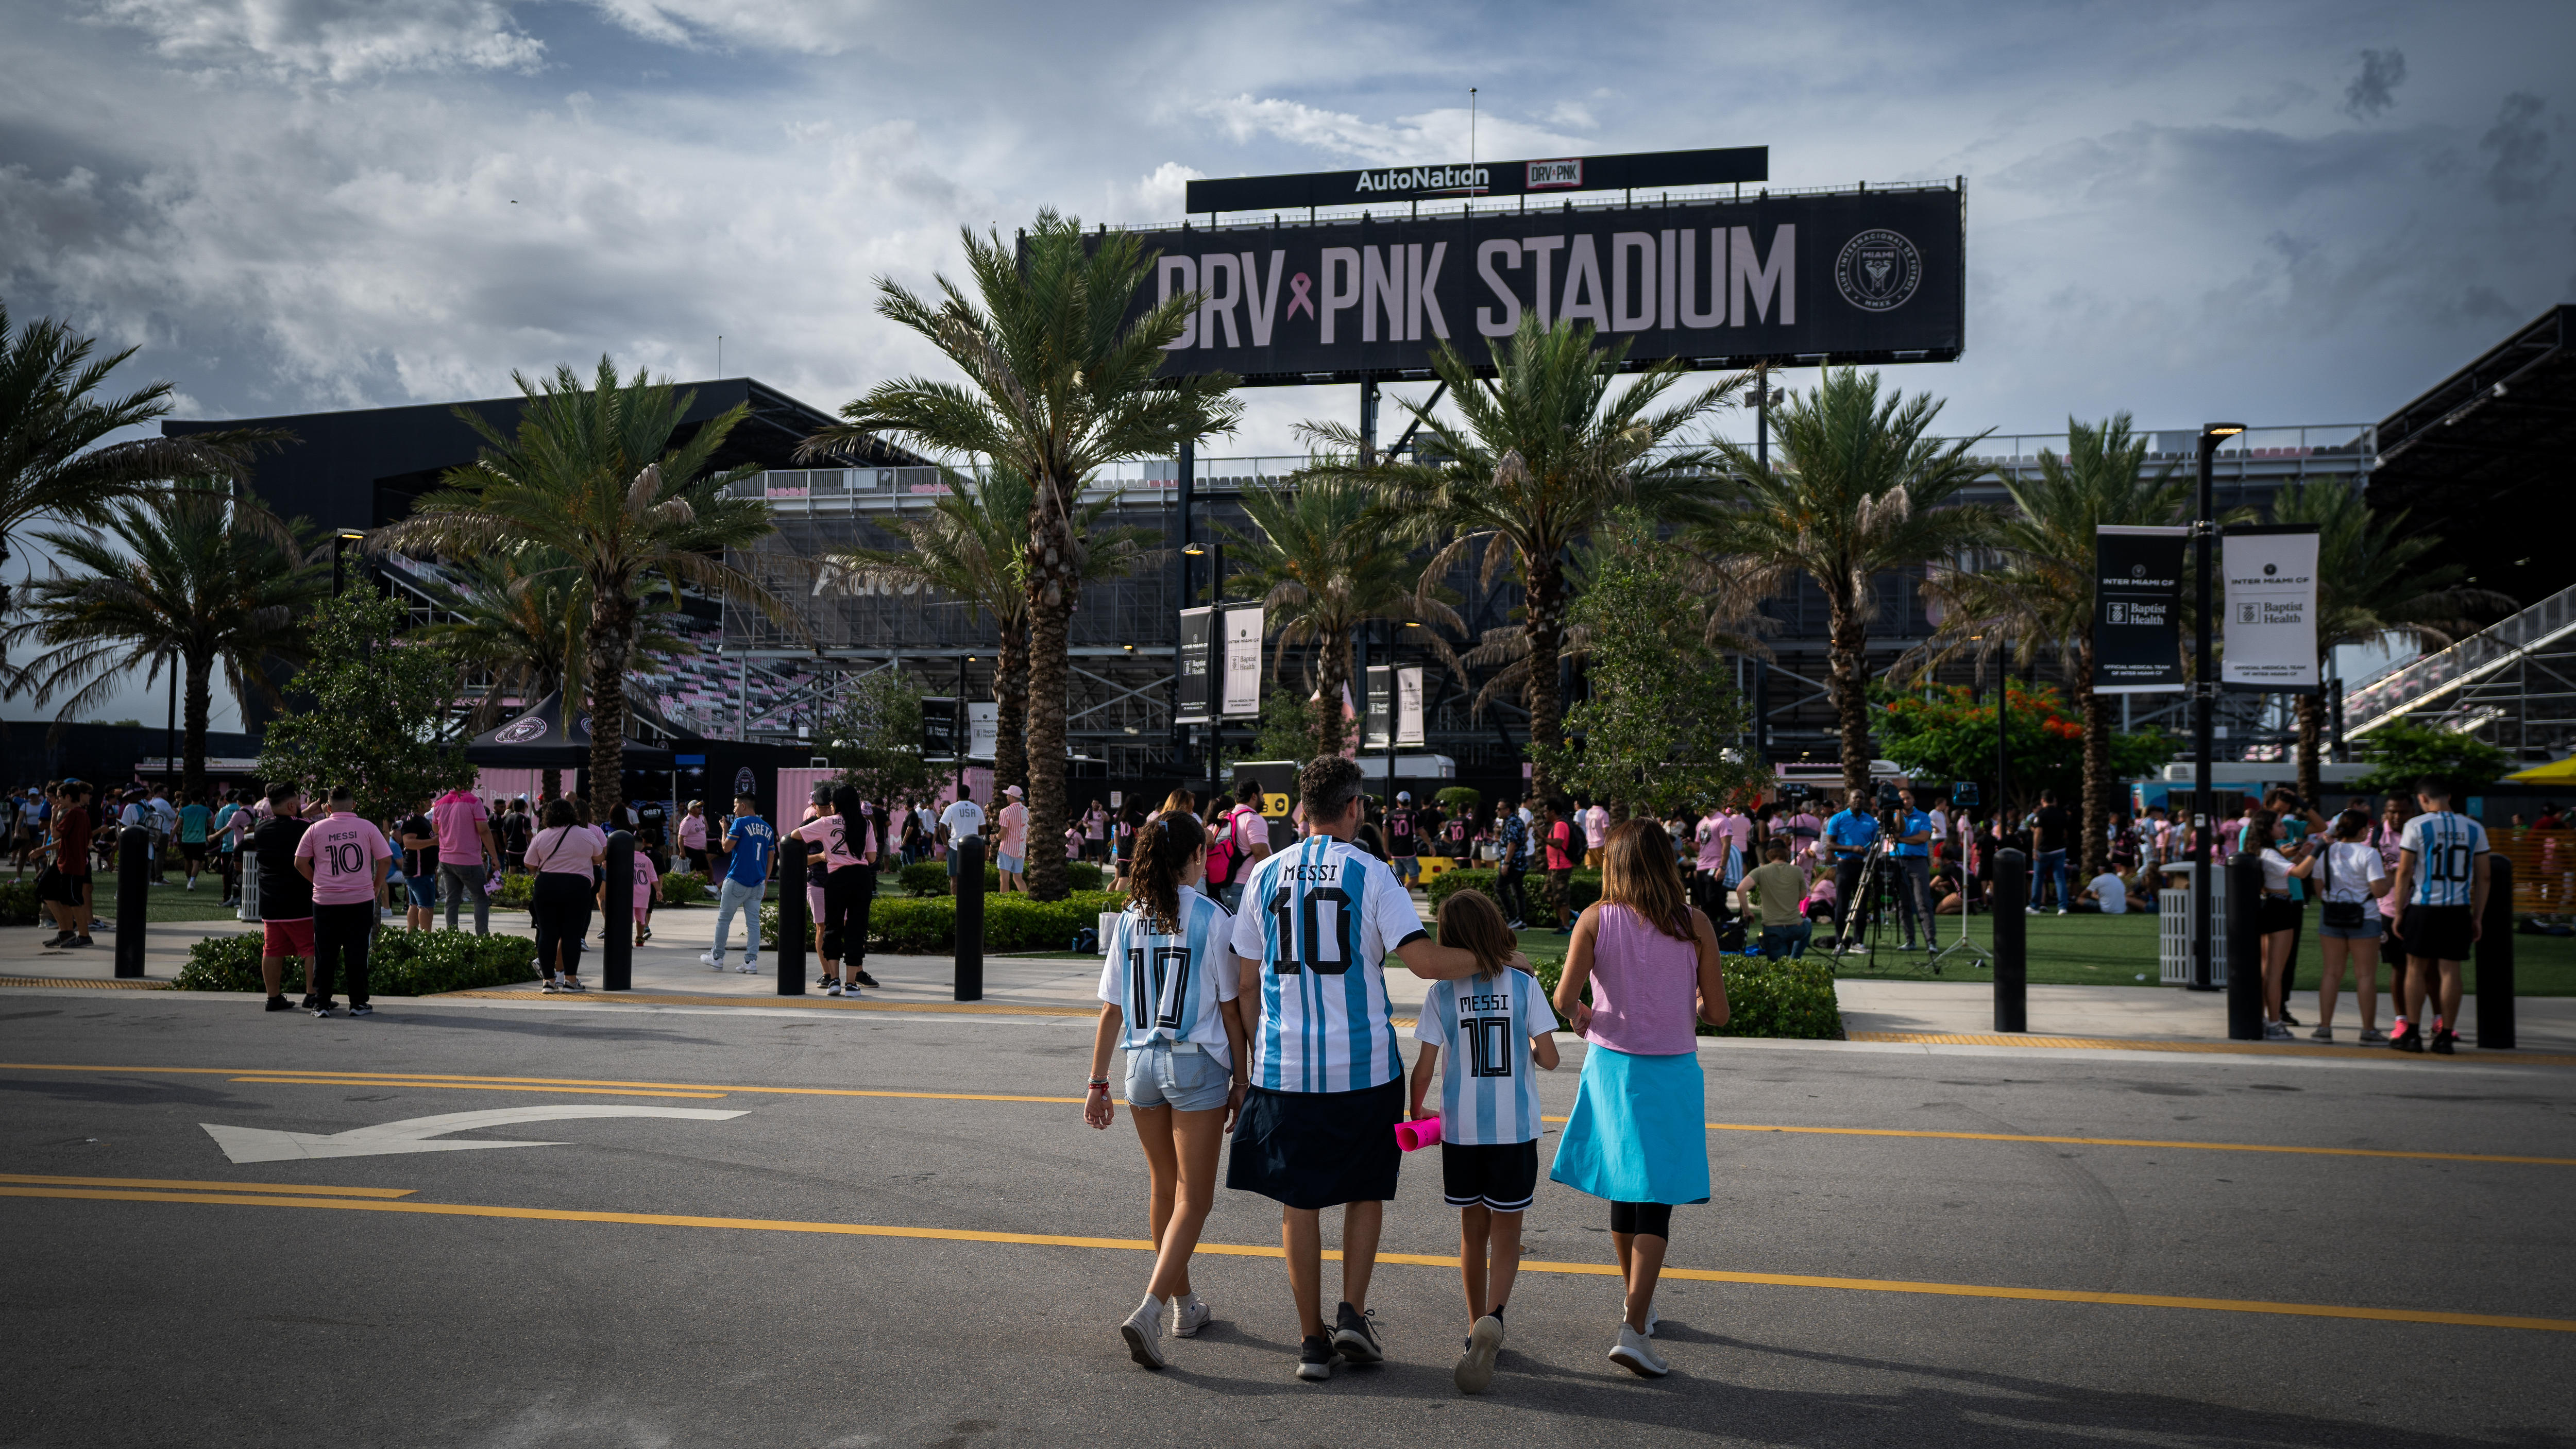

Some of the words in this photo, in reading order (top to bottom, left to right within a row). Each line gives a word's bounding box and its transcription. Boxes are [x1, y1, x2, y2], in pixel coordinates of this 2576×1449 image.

[1355, 165, 1489, 192] AutoNation
[1532, 166, 1551, 181] DRV
[1556, 164, 1577, 180] PNK
[1840, 233, 1904, 268] INTERNACIONAL
[1157, 250, 1286, 350] DRV
[1320, 242, 1451, 345] PNK
[1477, 224, 1795, 337] STADIUM
[1839, 271, 1851, 293] CLUB
[2131, 578, 2160, 587] MIAMI
[2130, 603, 2167, 616] Baptist
[2263, 602, 2303, 614] Baptist
[2130, 614, 2164, 626] Health
[2263, 613, 2301, 623] Health
[1192, 659, 1206, 668] Baptist
[1240, 655, 1257, 663] Baptist
[959, 808, 976, 817] USA
[328, 831, 357, 842] MESSI
[744, 823, 772, 841] VEGETA
[1120, 821, 1131, 837] 10
[1391, 820, 1409, 837] 10
[1450, 825, 1465, 841] 10
[830, 828, 847, 855] 2
[325, 842, 363, 876] 10
[756, 842, 762, 861] 1
[2431, 843, 2470, 881] 10
[1283, 864, 1338, 881] MESSI
[1267, 887, 1352, 975] 10
[1127, 946, 1192, 1030] 10
[1460, 994, 1509, 1013] MESSI
[1460, 1016, 1512, 1077] 10
